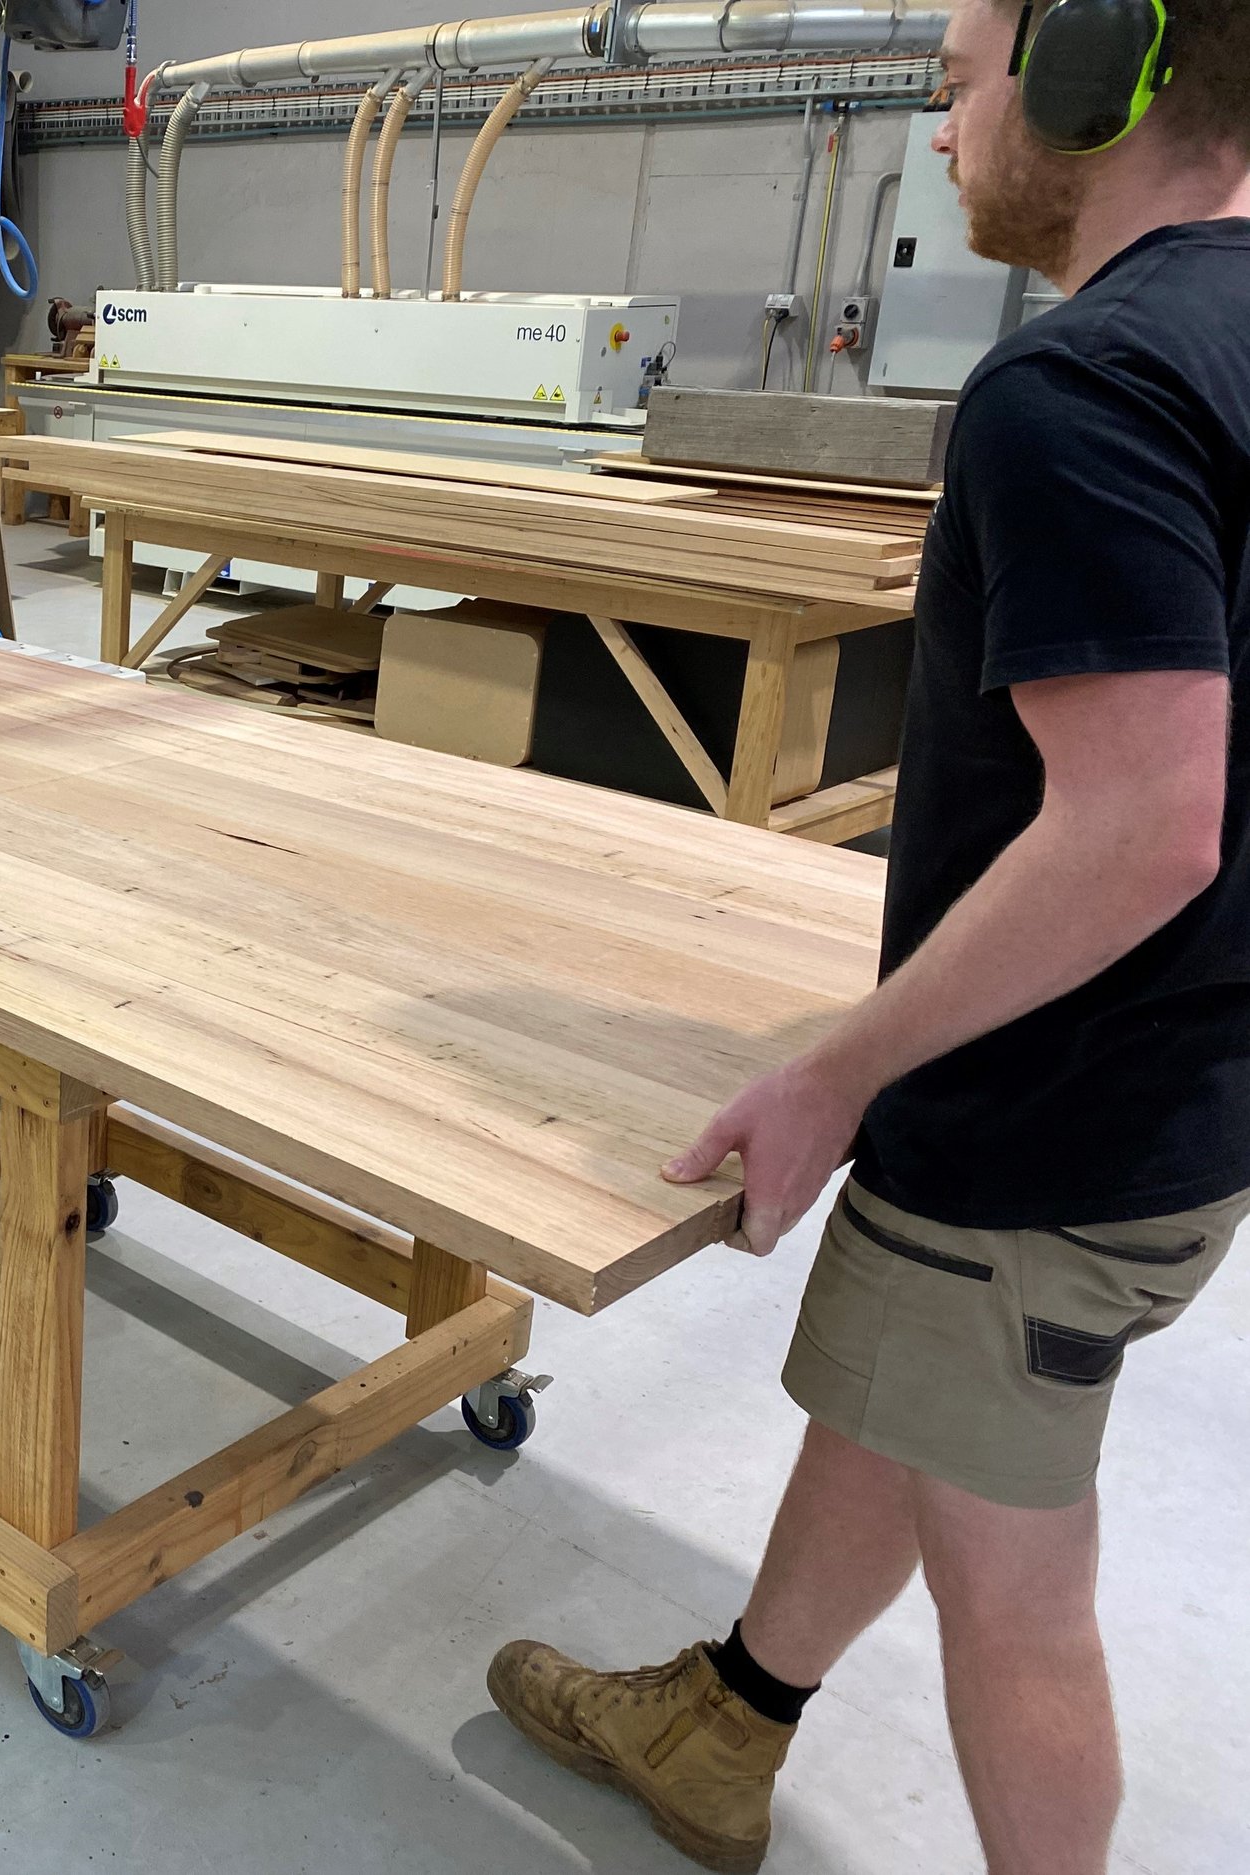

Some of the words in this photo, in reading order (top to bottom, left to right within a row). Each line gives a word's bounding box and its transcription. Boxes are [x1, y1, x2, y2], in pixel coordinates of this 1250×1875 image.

[117, 308, 147, 323] scm
[517, 327, 542, 341] me
[545, 324, 566, 342] 40
